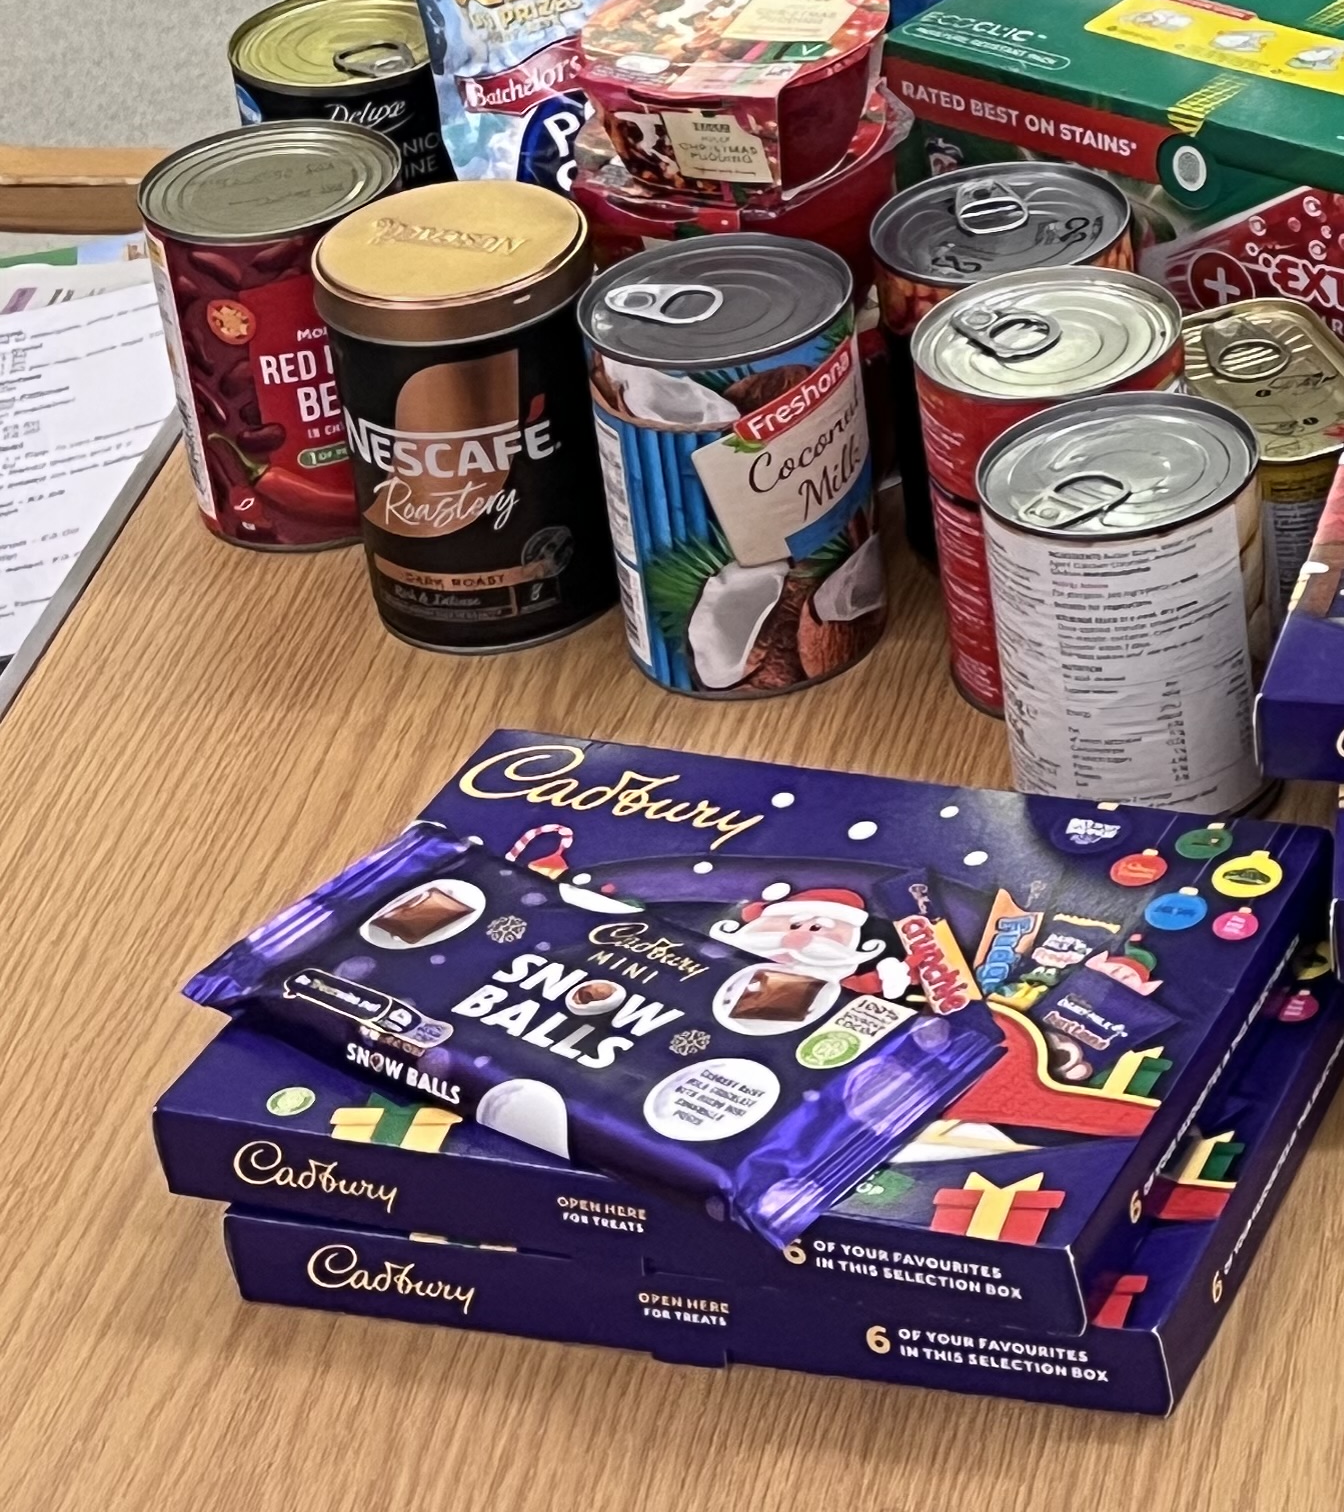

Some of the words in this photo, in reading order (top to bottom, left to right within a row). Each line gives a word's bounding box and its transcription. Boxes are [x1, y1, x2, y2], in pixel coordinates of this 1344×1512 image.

[466, 54, 582, 106] Batchelors
[901, 80, 966, 111] RATED
[970, 99, 1020, 128] BEST
[1024, 114, 1055, 137] ON
[260, 350, 316, 385] RED
[747, 349, 852, 441] Freshona
[373, 476, 520, 530] Roastery
[798, 444, 861, 522] Milk
[459, 745, 766, 850] Cadbury
[588, 922, 711, 978] Cadbury
[588, 949, 661, 982] MINI
[493, 954, 685, 1038] SNOW
[451, 985, 636, 1069] BALLS
[346, 1043, 403, 1080] SNOW
[406, 1066, 461, 1105] BALLS
[233, 1140, 398, 1214] Cadbury
[307, 1244, 475, 1315] Cadbury
[638, 1291, 683, 1310] OPEN
[686, 1296, 730, 1315] HERE
[866, 1325, 891, 1355] 6
[898, 1327, 921, 1343] OF
[925, 1330, 975, 1350] YOUR
[978, 1338, 1090, 1364] FAVOURITES
[899, 1345, 920, 1359] IN
[923, 1347, 964, 1366] THIS
[968, 1352, 1069, 1377] SELECTION
[1071, 1365, 1110, 1384] BOX
